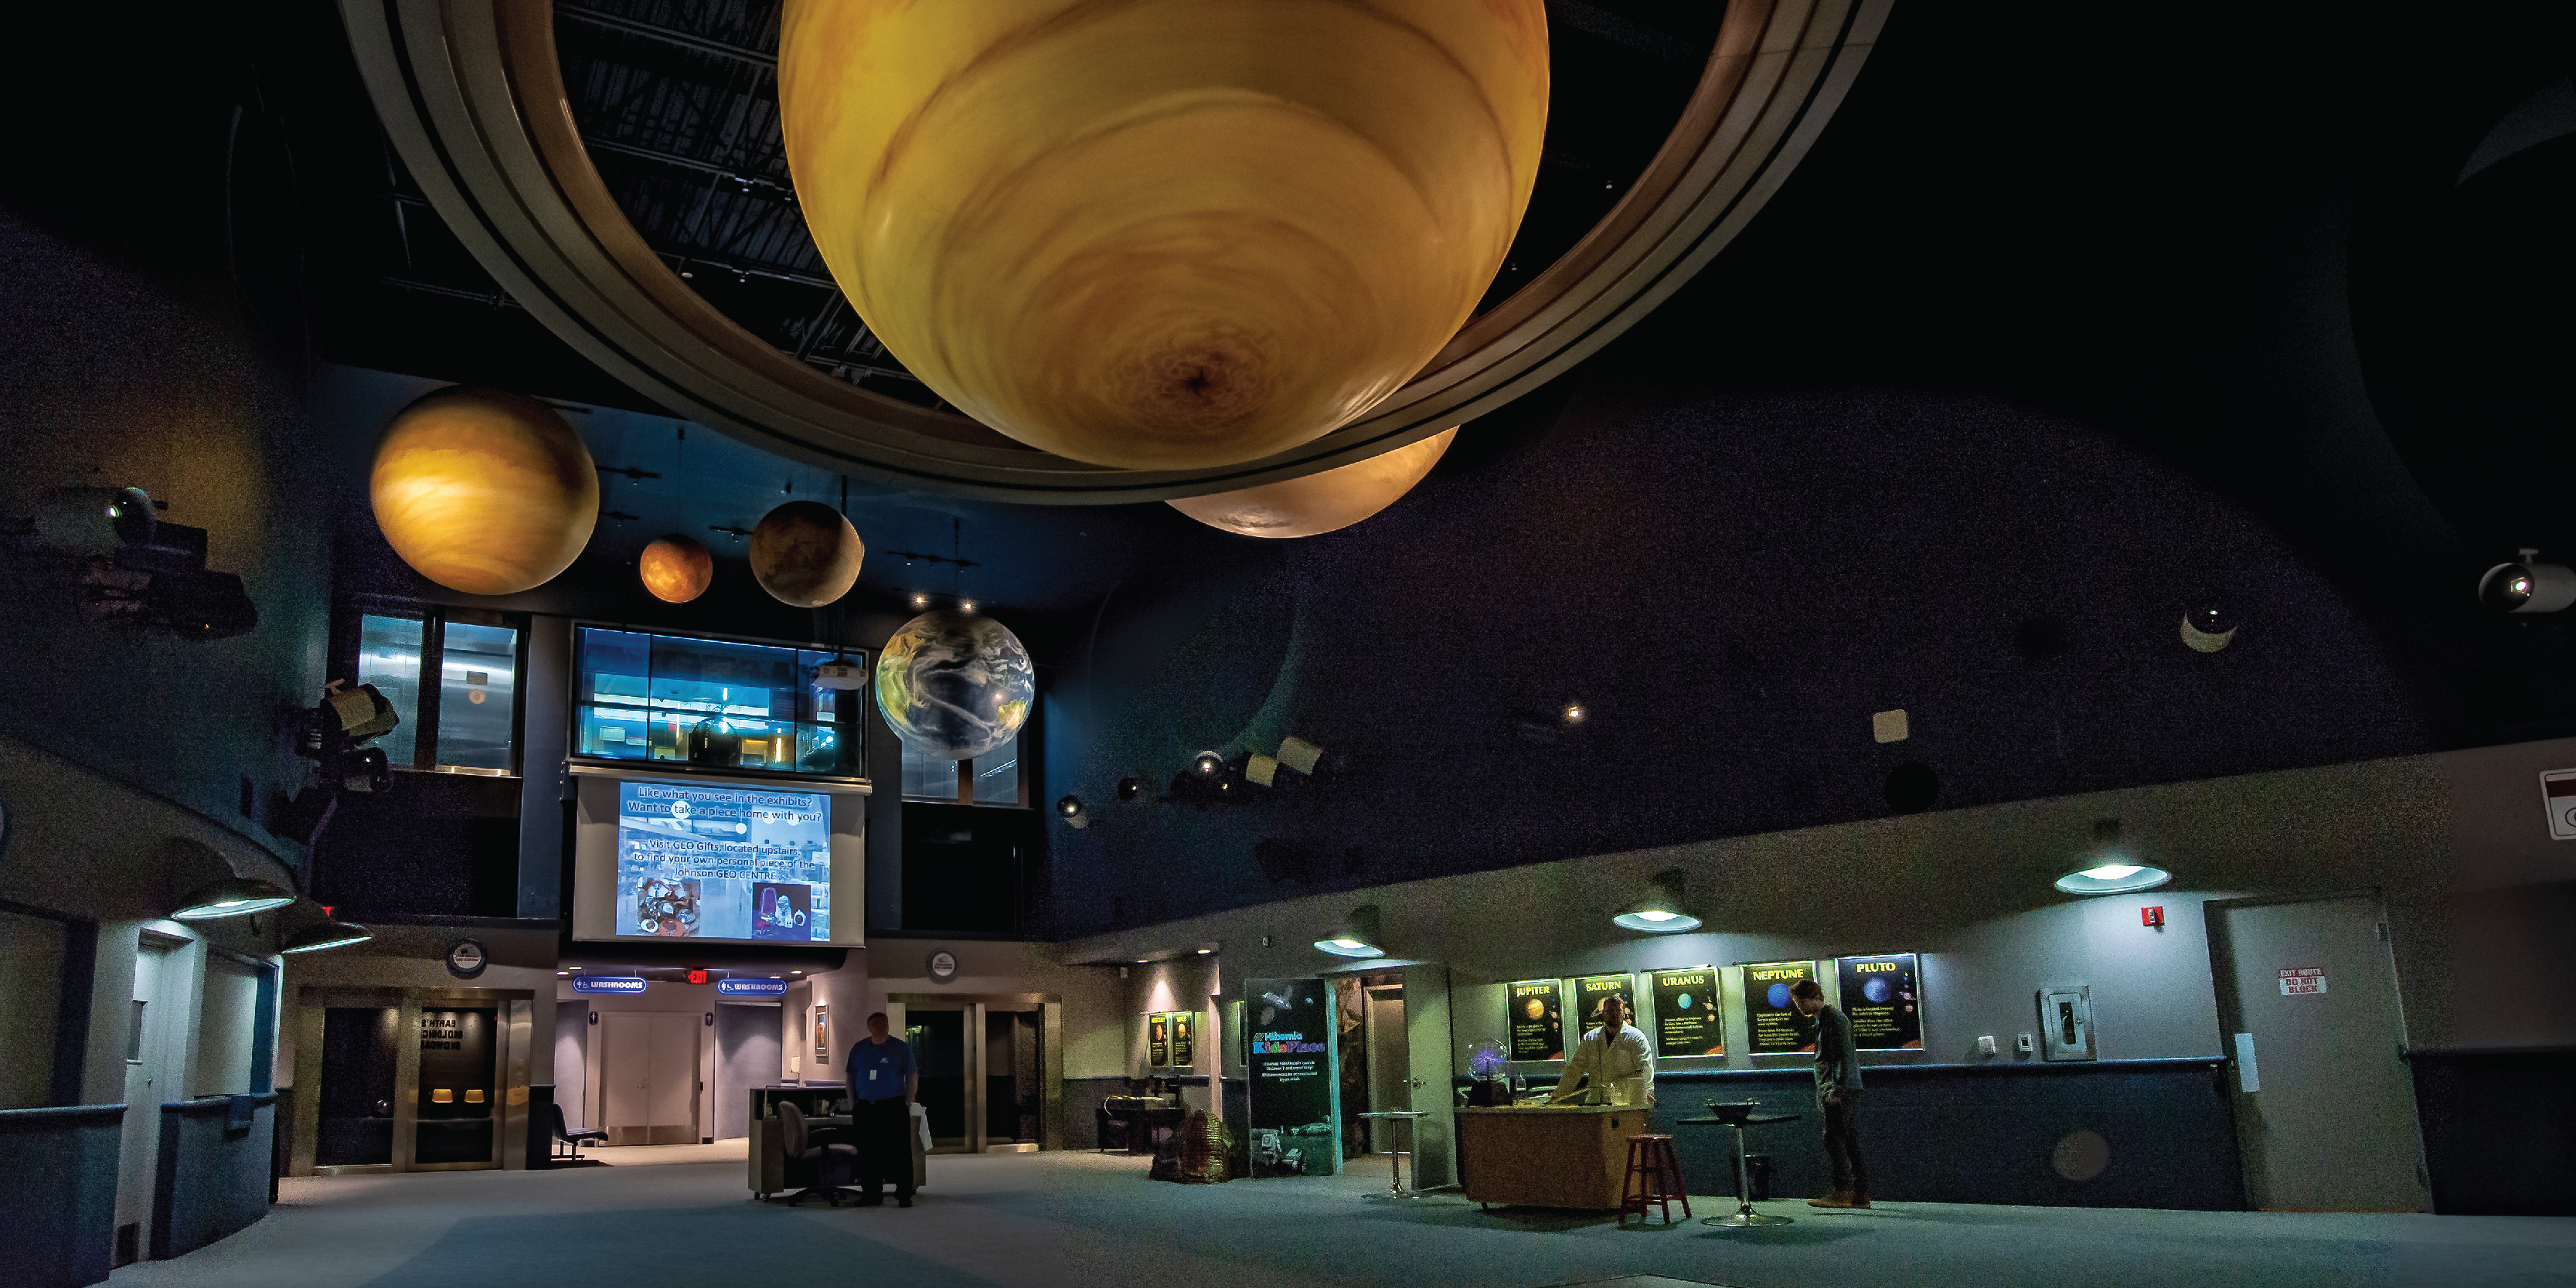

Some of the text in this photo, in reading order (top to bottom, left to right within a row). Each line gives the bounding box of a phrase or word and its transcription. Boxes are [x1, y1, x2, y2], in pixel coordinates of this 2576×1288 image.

[638, 787, 812, 807] Like what you see in the exhibits?
[628, 800, 658, 813] Want
[661, 804, 672, 813] to
[674, 804, 697, 814] take
[709, 807, 737, 818] piece
[740, 808, 769, 819] home
[771, 811, 794, 821] with
[798, 812, 822, 823] you?
[649, 839, 670, 849] Visit
[673, 841, 694, 850] GEO
[696, 841, 722, 852] Gifts,
[724, 843, 759, 853] located
[647, 852, 665, 862] find
[669, 855, 691, 864] your
[716, 858, 757, 866] personal
[760, 858, 784, 868] piece
[787, 859, 797, 868] of
[799, 860, 815, 869] the
[674, 867, 777, 880] Johnson GEO CENTRE
[1752, 968, 1804, 980] NEPTUNE
[1856, 962, 1896, 973] PLUTO
[690, 970, 707, 984] EXIT
[1662, 975, 1705, 987] URANUS
[1516, 985, 1550, 997] JUPITER
[1586, 980, 1621, 992] SATURN
[2288, 985, 2318, 994] BLOCK
[1253, 1040, 1325, 1055] KidsPlace
